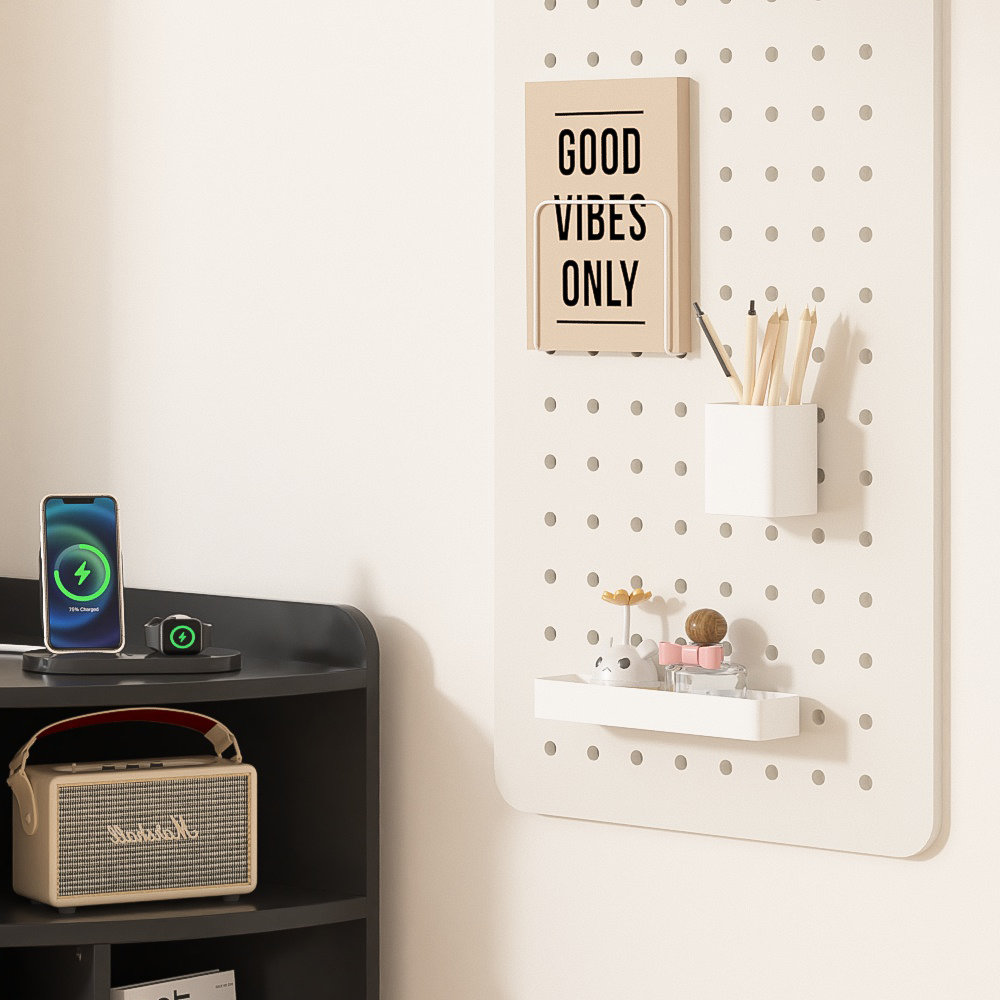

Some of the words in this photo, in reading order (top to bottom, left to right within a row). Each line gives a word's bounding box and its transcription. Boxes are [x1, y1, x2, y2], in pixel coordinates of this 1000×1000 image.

[558, 127, 641, 176] GOOD
[553, 194, 647, 242] VIBES
[562, 260, 639, 308] ONLY
